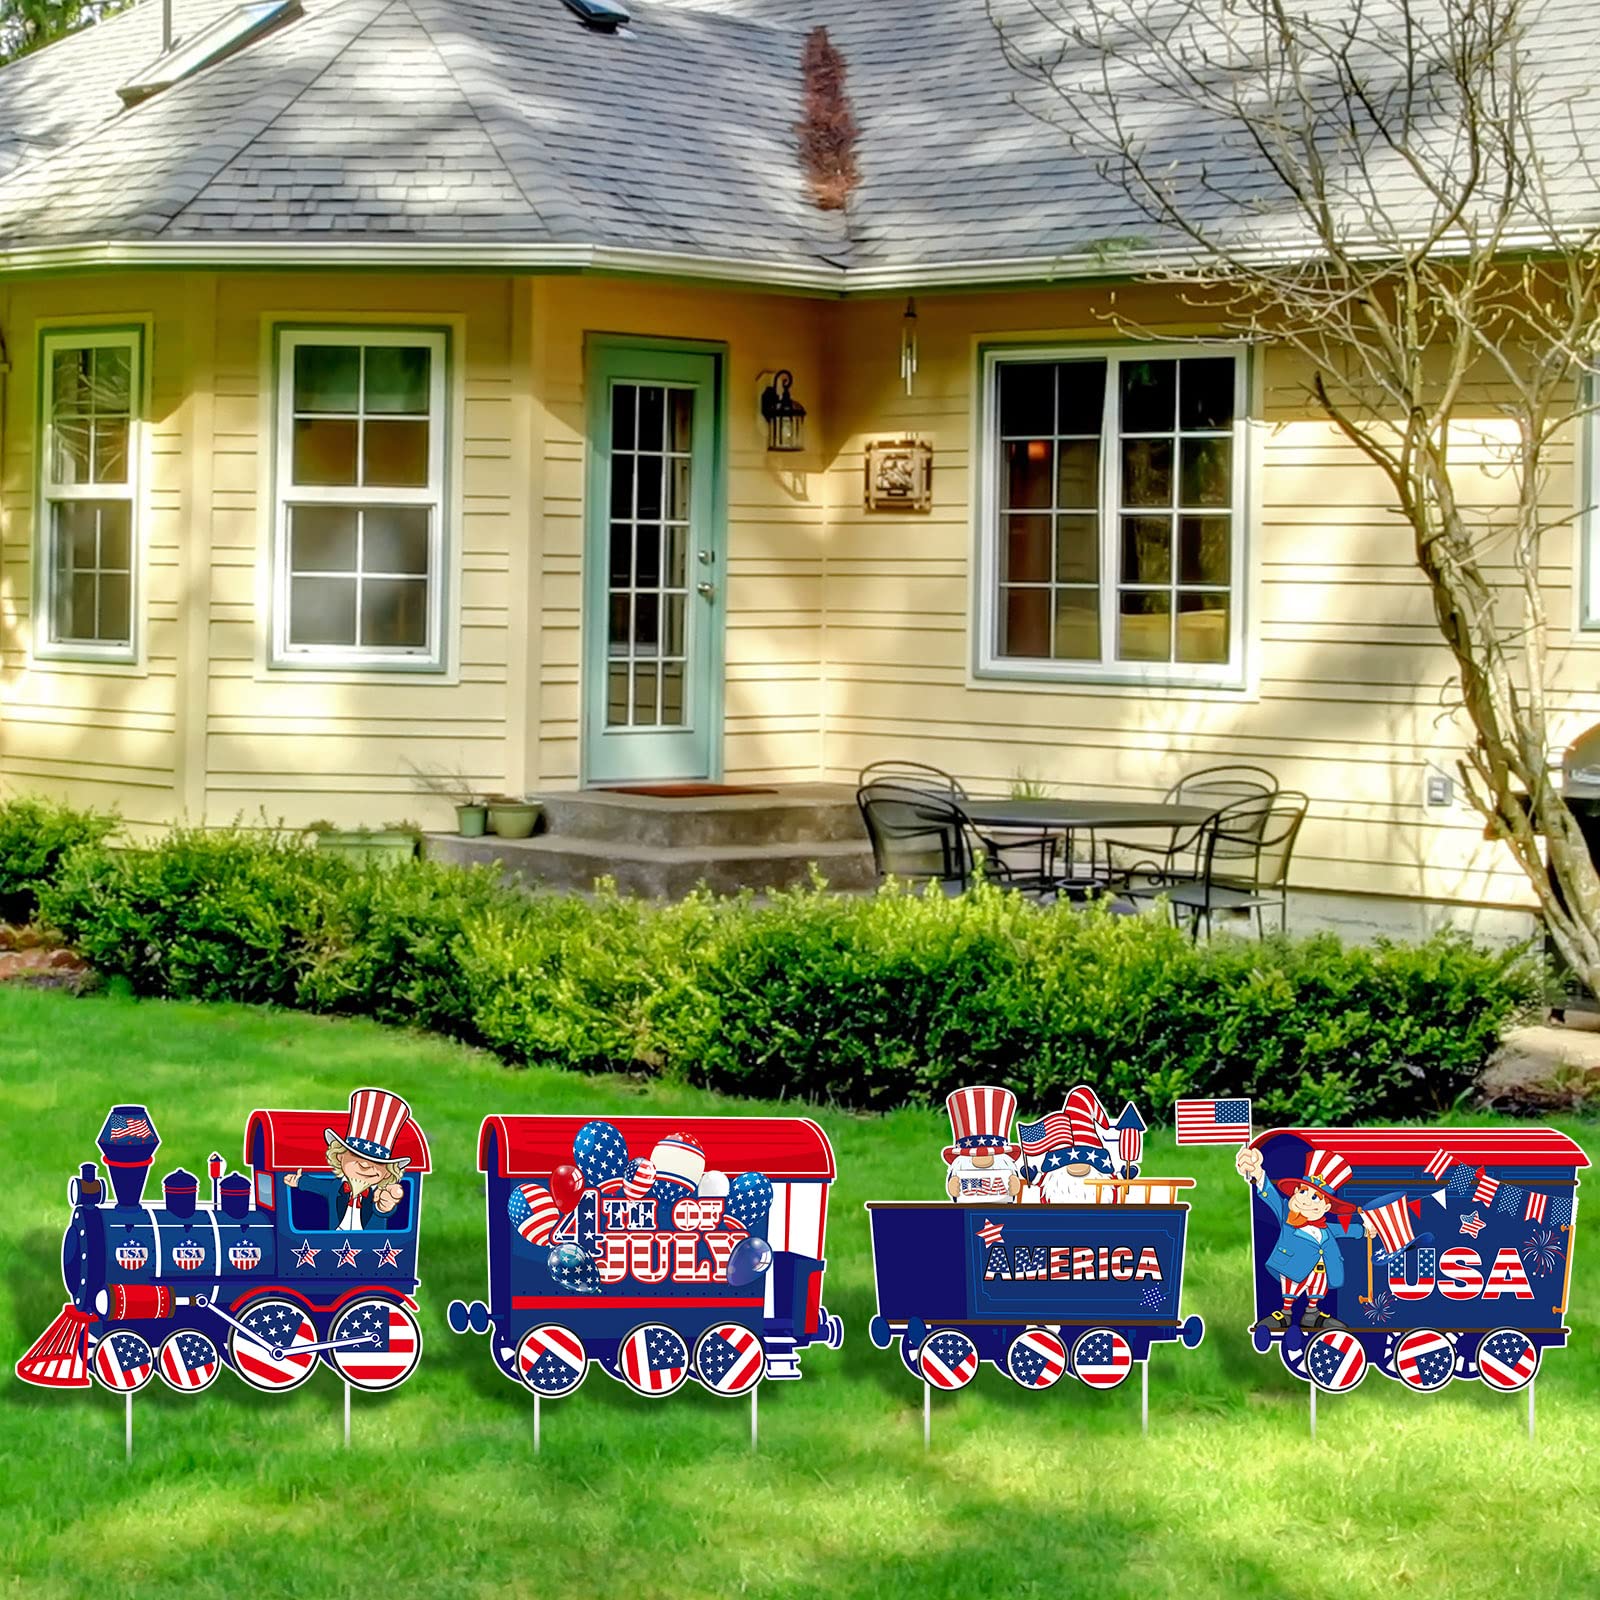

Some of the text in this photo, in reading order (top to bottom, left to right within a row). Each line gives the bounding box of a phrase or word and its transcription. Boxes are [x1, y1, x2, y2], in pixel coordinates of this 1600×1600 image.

[961, 1177, 1007, 1196] USA
[673, 1199, 725, 1231] OF
[119, 1249, 146, 1259] USA
[176, 1249, 203, 1259] USA
[232, 1249, 259, 1259] USA
[599, 1232, 749, 1283] JULY
[983, 1246, 1164, 1281] AMERICA
[1388, 1246, 1535, 1301] USA
